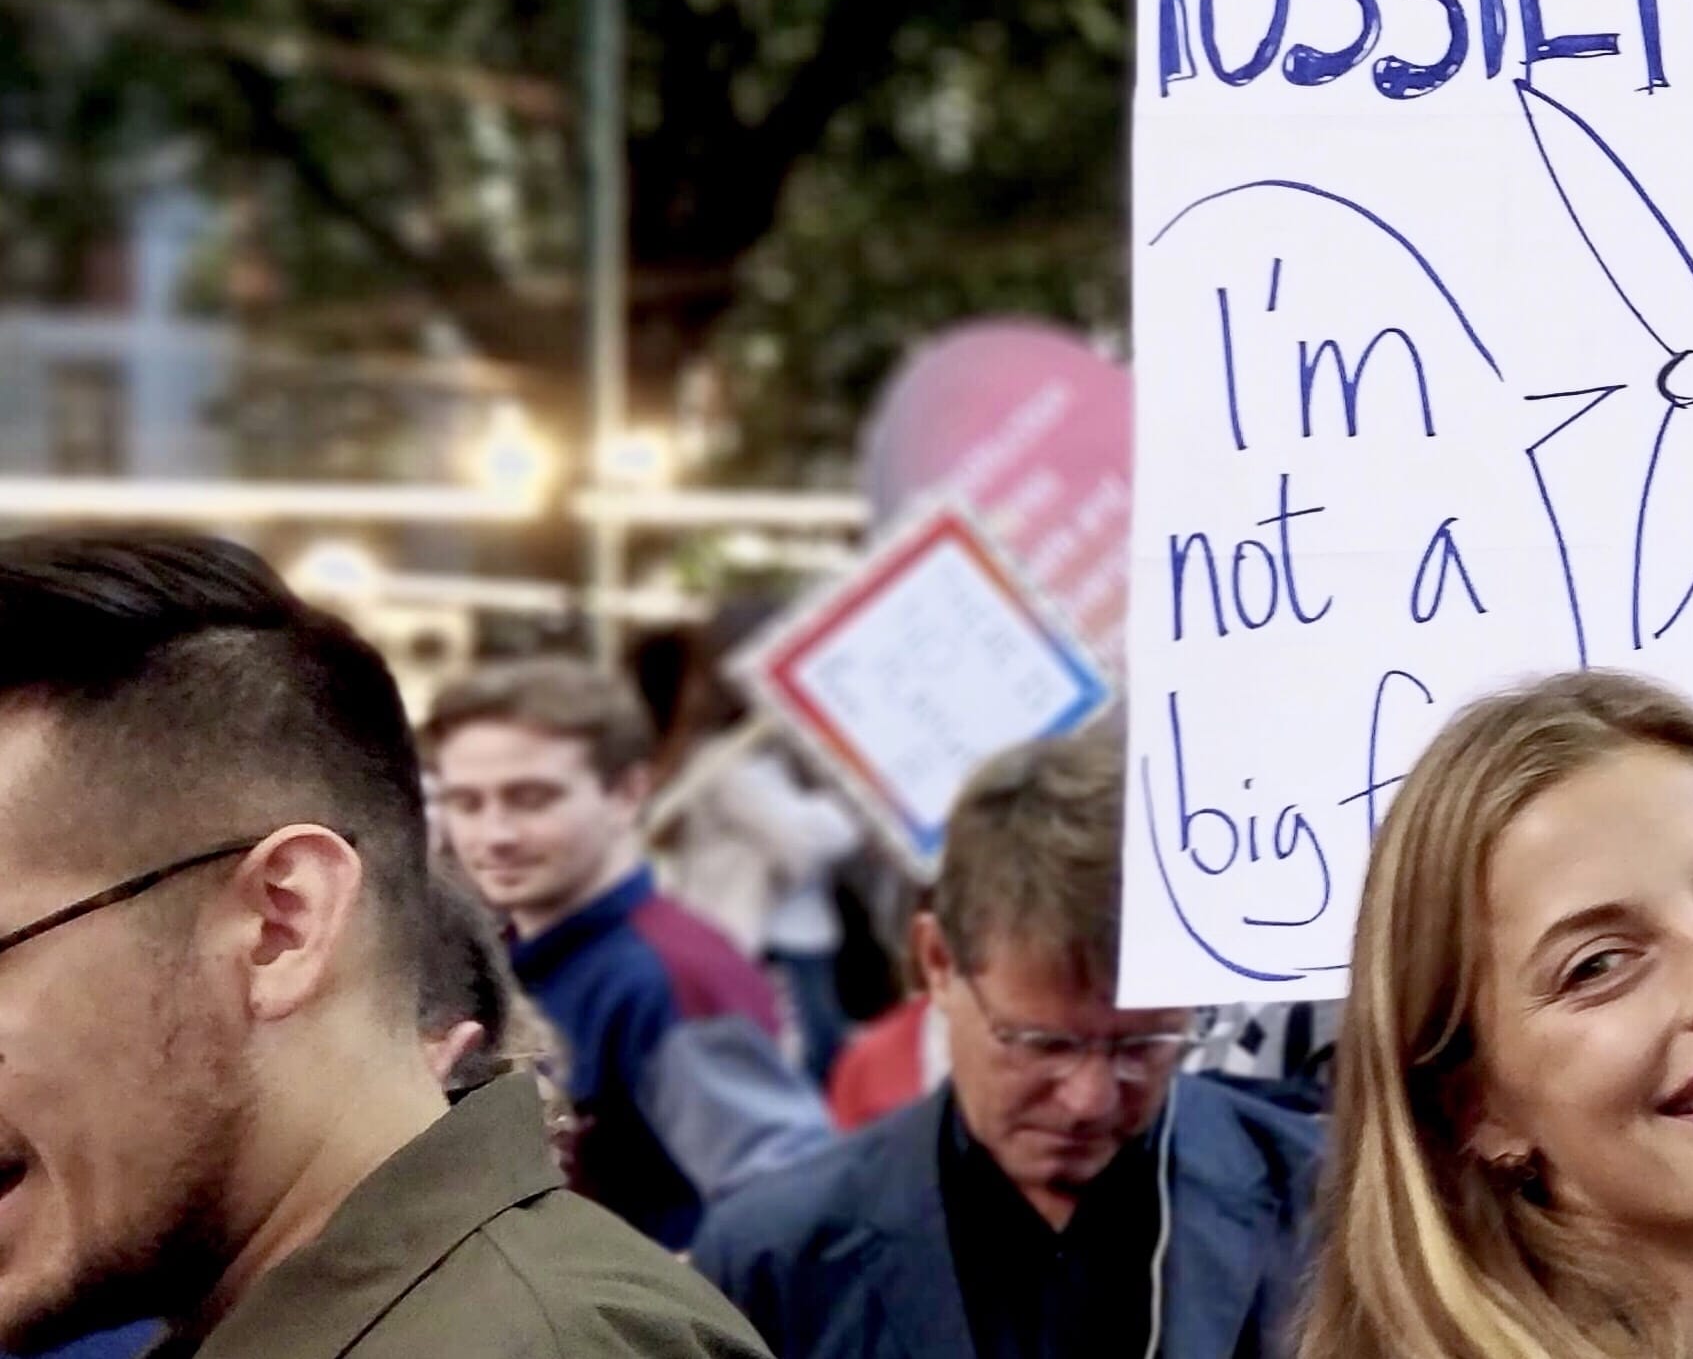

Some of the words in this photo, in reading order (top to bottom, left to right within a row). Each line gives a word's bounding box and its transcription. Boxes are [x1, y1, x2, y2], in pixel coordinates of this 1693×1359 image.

[1218, 257, 1435, 446] I'm
[1169, 473, 1334, 641] not
[1410, 516, 1487, 624] a
[1168, 691, 1331, 927] big
